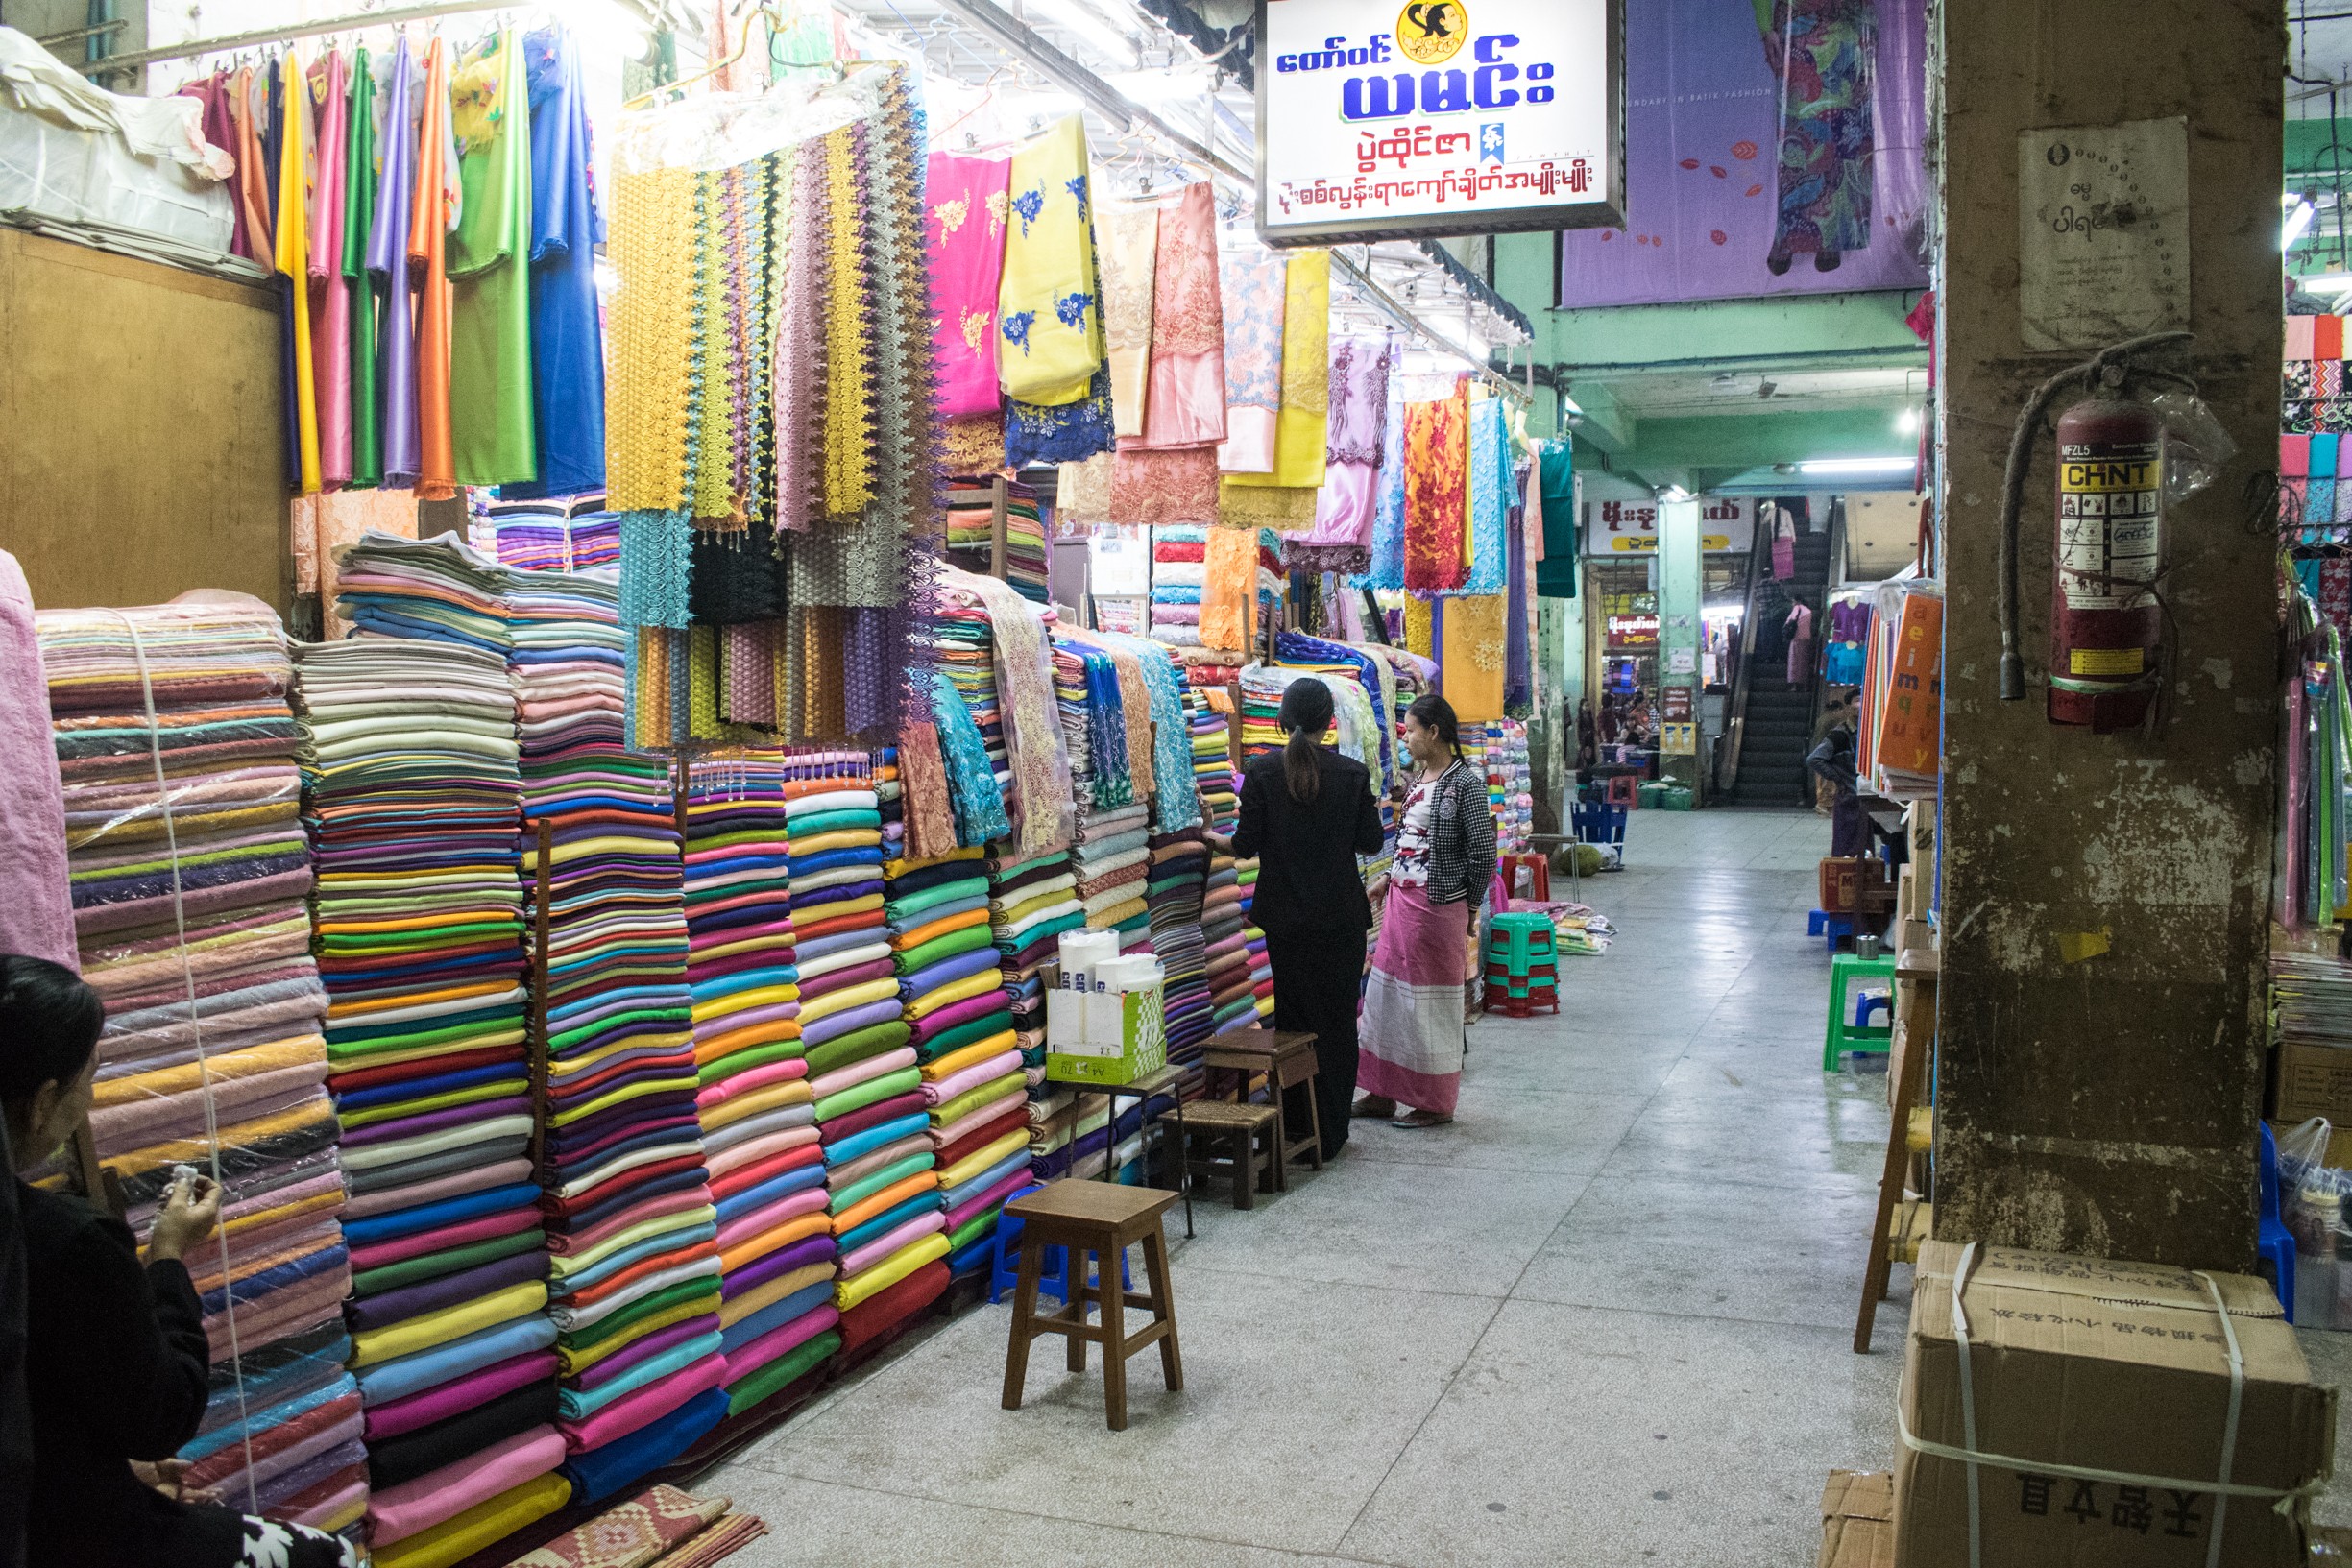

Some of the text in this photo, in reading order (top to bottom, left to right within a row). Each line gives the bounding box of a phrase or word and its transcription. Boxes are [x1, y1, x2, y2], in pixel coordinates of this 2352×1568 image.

[1276, 34, 1392, 73] တော်ဝင်
[1342, 34, 1555, 121] ယမင်း
[1690, 92, 1719, 102] BATIK
[1725, 87, 1771, 98] FASHION
[2061, 445, 2090, 456] MFZL5
[1908, 626, 1924, 641] e
[1907, 647, 1916, 667] i
[1897, 673, 1919, 690] m
[1898, 695, 1912, 716] q
[1914, 749, 1929, 768] y
